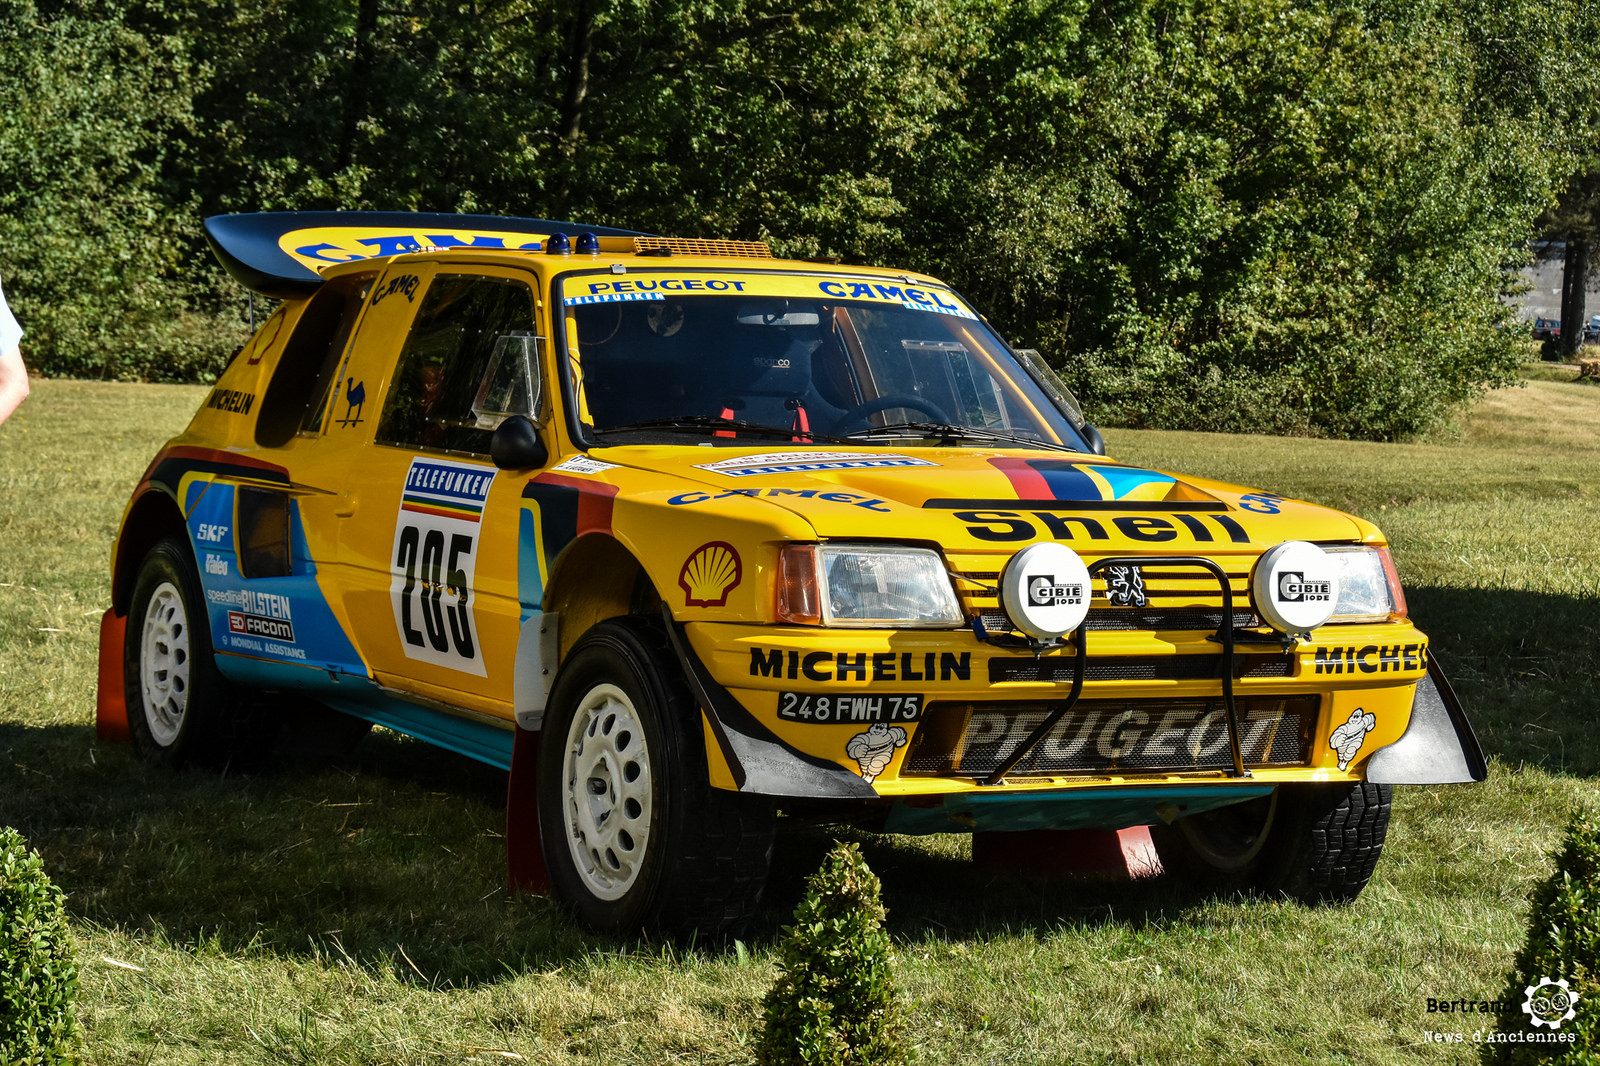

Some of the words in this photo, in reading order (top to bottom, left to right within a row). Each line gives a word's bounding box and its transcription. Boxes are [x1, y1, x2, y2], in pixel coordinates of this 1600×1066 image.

[372, 274, 420, 305] CAMEL
[564, 292, 664, 305] TELEFUNKEN
[588, 280, 746, 294] PEUGEOT
[818, 281, 958, 310] CAMEL
[206, 389, 255, 415] MICHELIN
[729, 460, 930, 475] TELEFUNKEN
[408, 466, 492, 496] TELEFUNKEN
[667, 488, 891, 512] CAMEL
[197, 523, 228, 542] SKF
[952, 511, 1250, 543] Shell
[207, 588, 243, 605] speedline
[241, 589, 291, 619] BILSTEIN
[397, 525, 474, 659] 205
[246, 618, 292, 638] FACOM
[230, 636, 262, 651] MONDIAL
[265, 642, 306, 659] ASSISTANCE
[750, 647, 971, 681] MICHELIN
[781, 692, 831, 720] 248
[836, 697, 882, 720] FWH
[888, 697, 918, 720] 75
